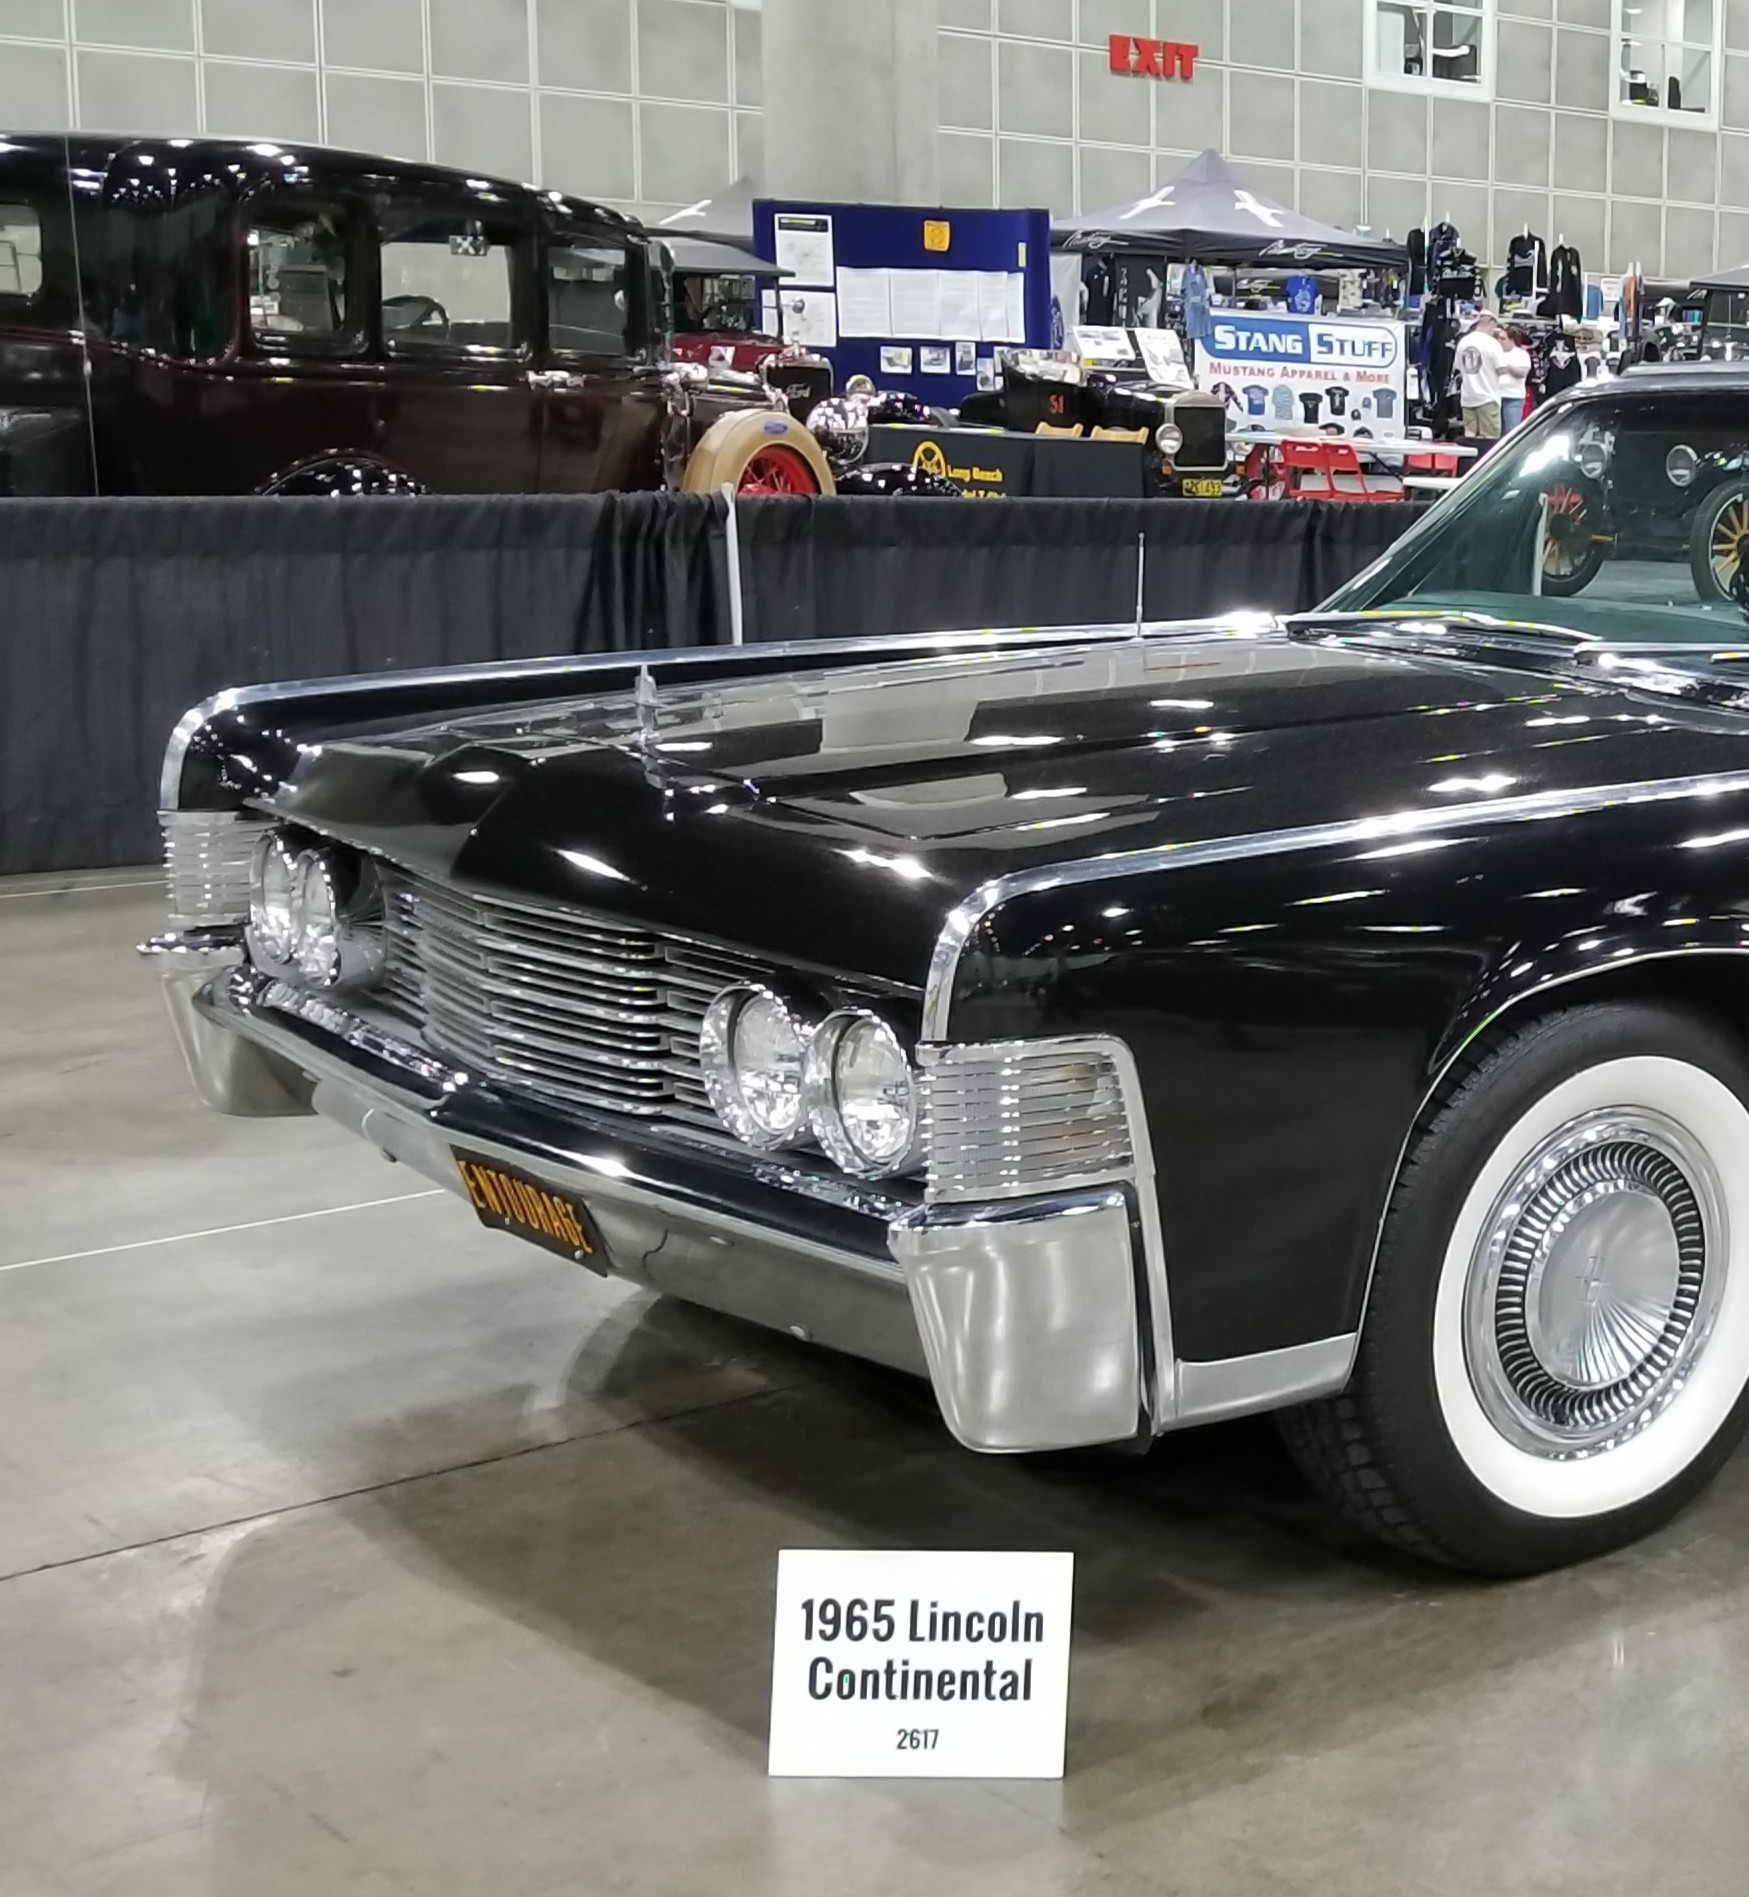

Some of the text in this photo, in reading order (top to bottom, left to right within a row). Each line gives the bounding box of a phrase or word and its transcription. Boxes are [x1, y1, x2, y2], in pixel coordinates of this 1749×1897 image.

[1108, 34, 1199, 80] EXIT
[1214, 325, 1393, 358] STANG STUFF
[1209, 362, 1275, 378] MUSTANG
[1280, 366, 1337, 381] APPAREL
[1356, 371, 1390, 384] MORE
[457, 1160, 593, 1254] ENTOURAGE
[802, 1598, 1044, 1643] 1965 Lincoln
[808, 1656, 1033, 1701] Continental
[896, 1729, 939, 1750] 2617
